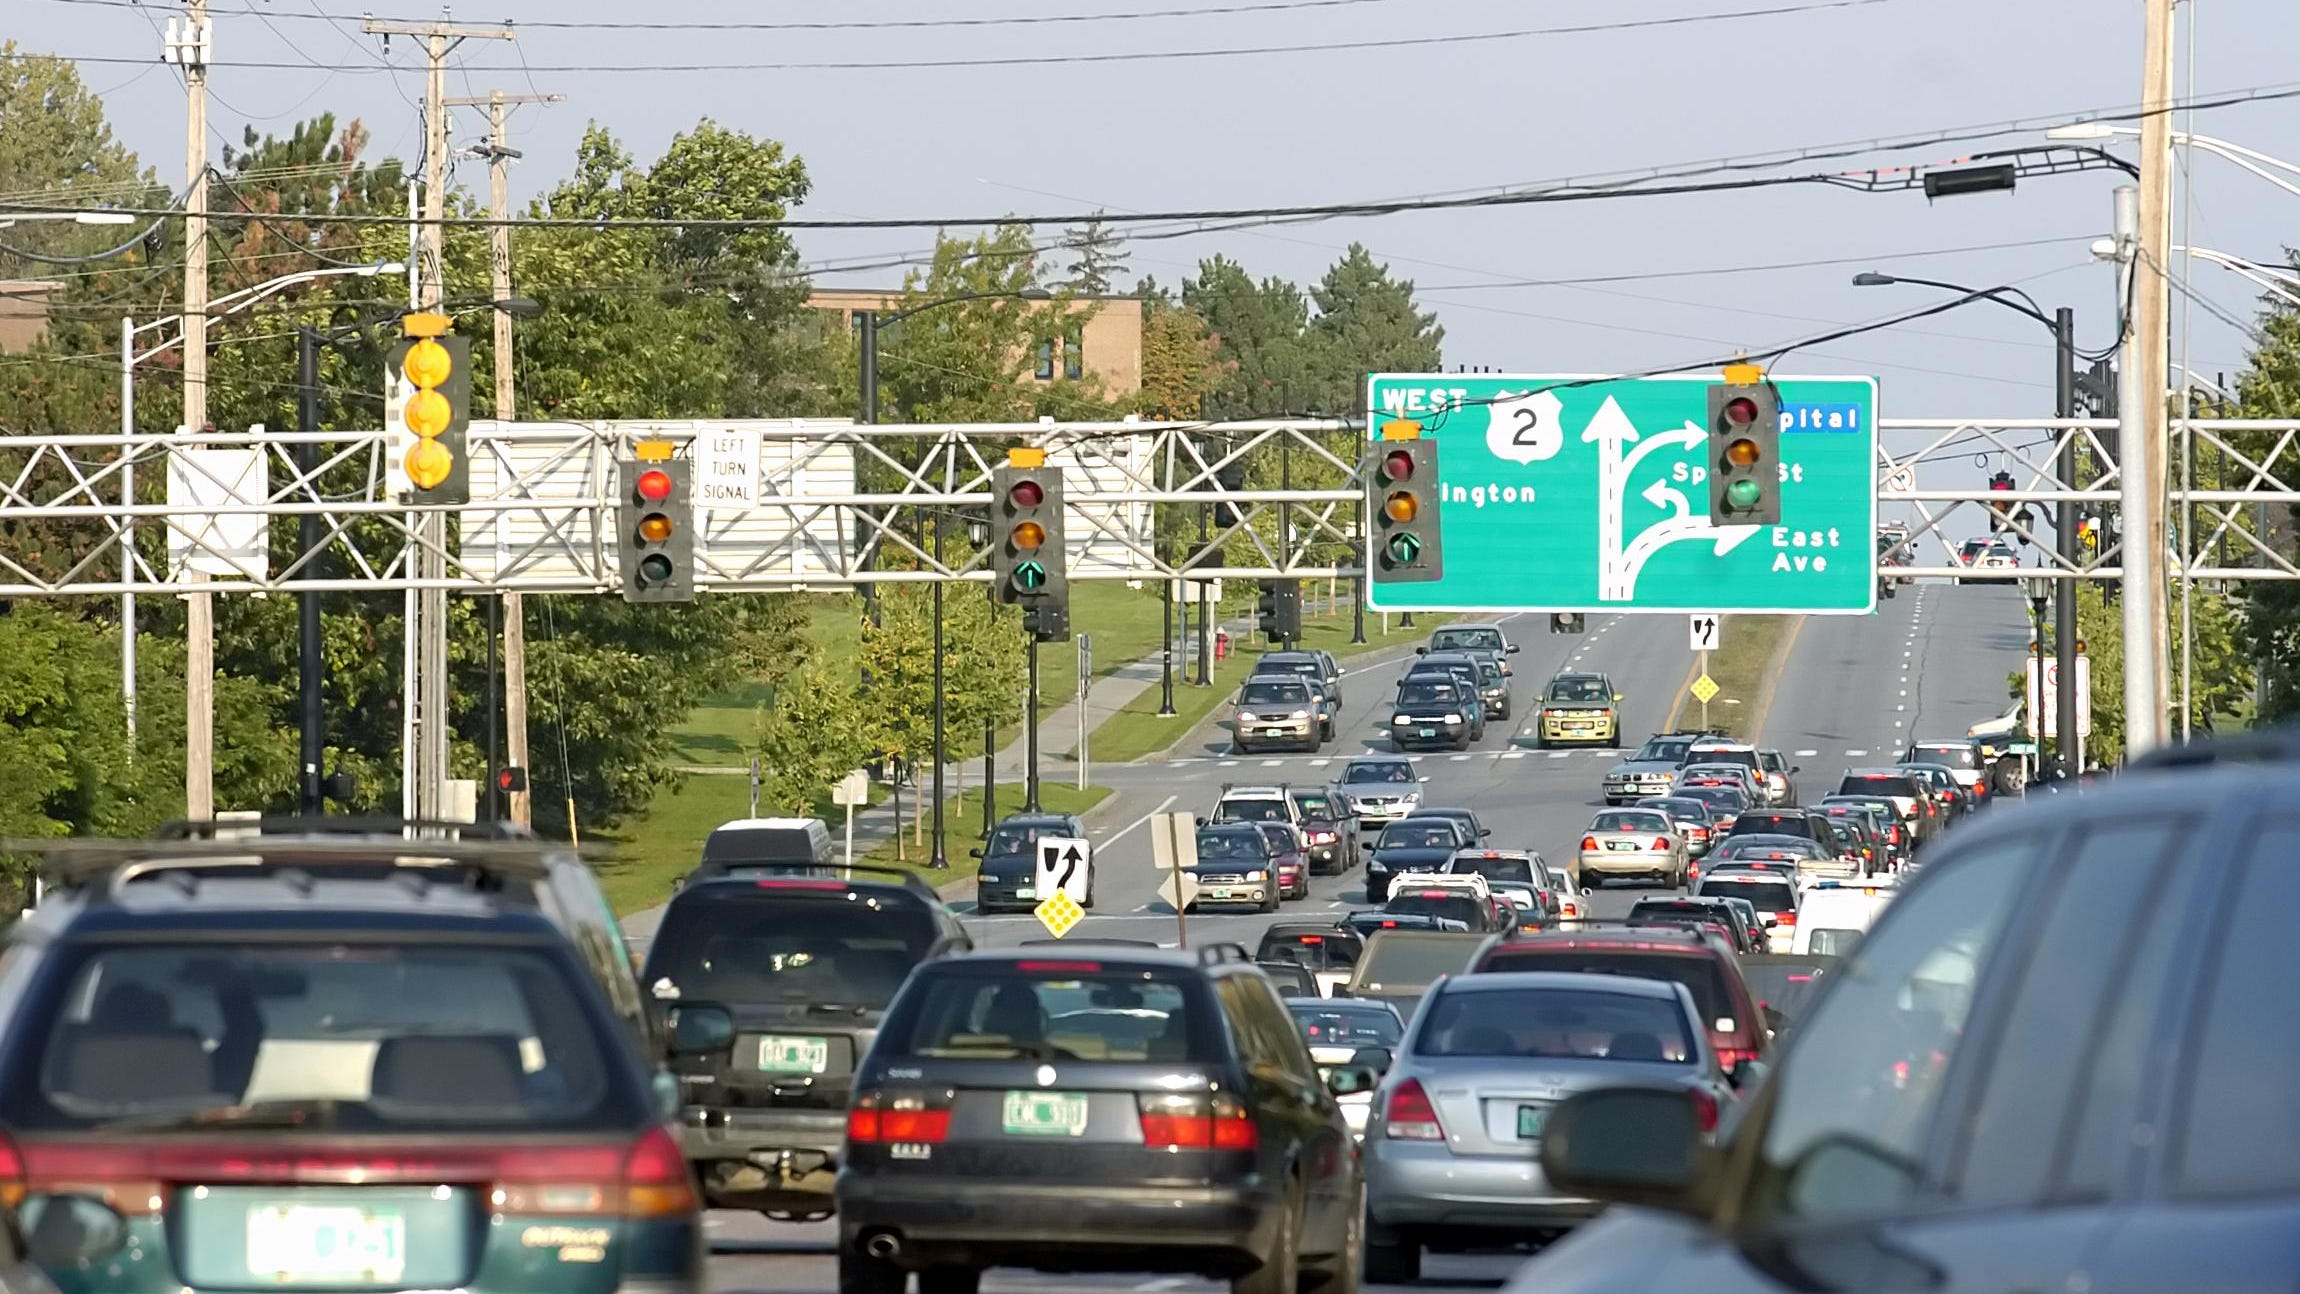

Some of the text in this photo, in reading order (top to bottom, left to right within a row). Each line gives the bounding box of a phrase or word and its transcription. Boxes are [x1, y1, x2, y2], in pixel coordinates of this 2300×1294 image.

[1382, 387, 1468, 413] WEST
[1512, 408, 1538, 446] 2
[1780, 407, 1857, 433] pital
[713, 438, 745, 453] LEFT
[713, 461, 747, 476] TURN
[704, 484, 751, 501] SIGNAL
[1441, 482, 1536, 509] ington
[1771, 527, 1840, 548] East
[1771, 552, 1828, 573] Ave
